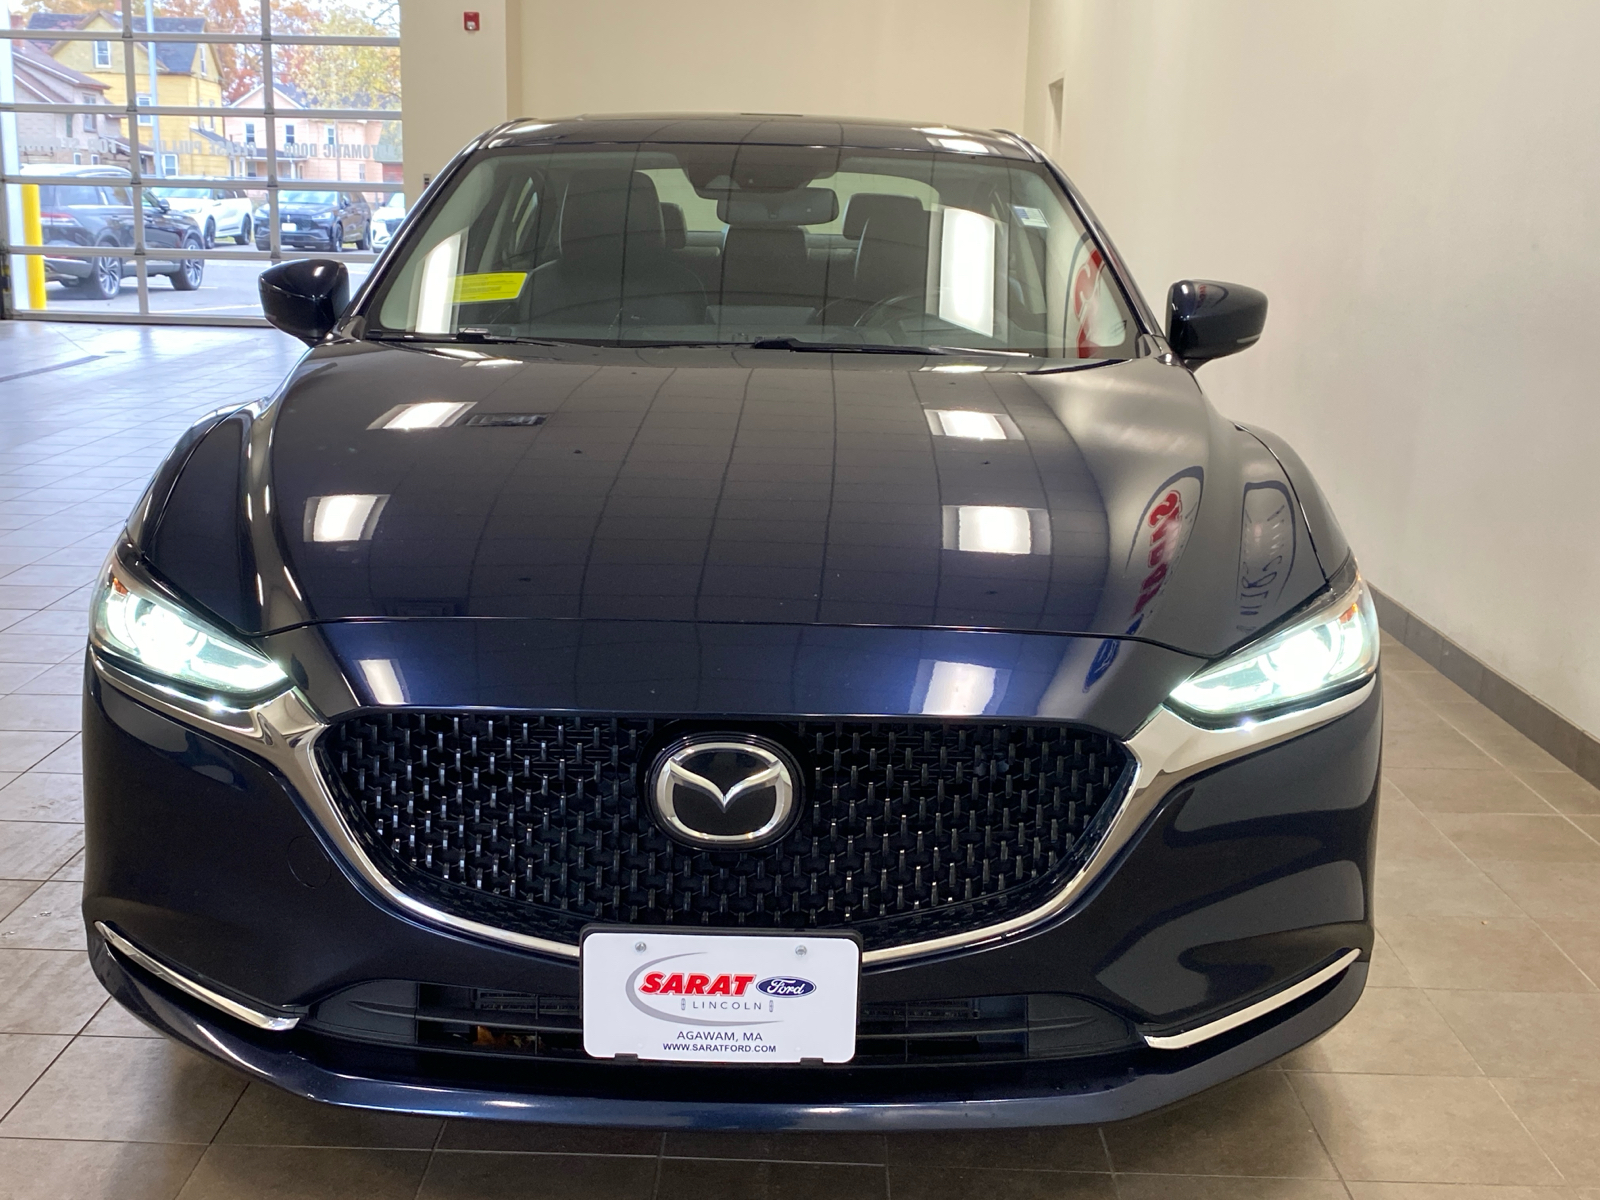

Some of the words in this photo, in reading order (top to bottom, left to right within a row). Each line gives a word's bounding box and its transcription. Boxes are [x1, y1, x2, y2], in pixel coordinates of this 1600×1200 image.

[638, 970, 757, 997] SARAT
[766, 978, 805, 996] Ford
[692, 1001, 763, 1011] LINCOLN
[676, 1031, 739, 1042] AGAWAM,
[743, 1032, 763, 1042] MA
[662, 1043, 777, 1053] WWW.SARATFORD.COM
